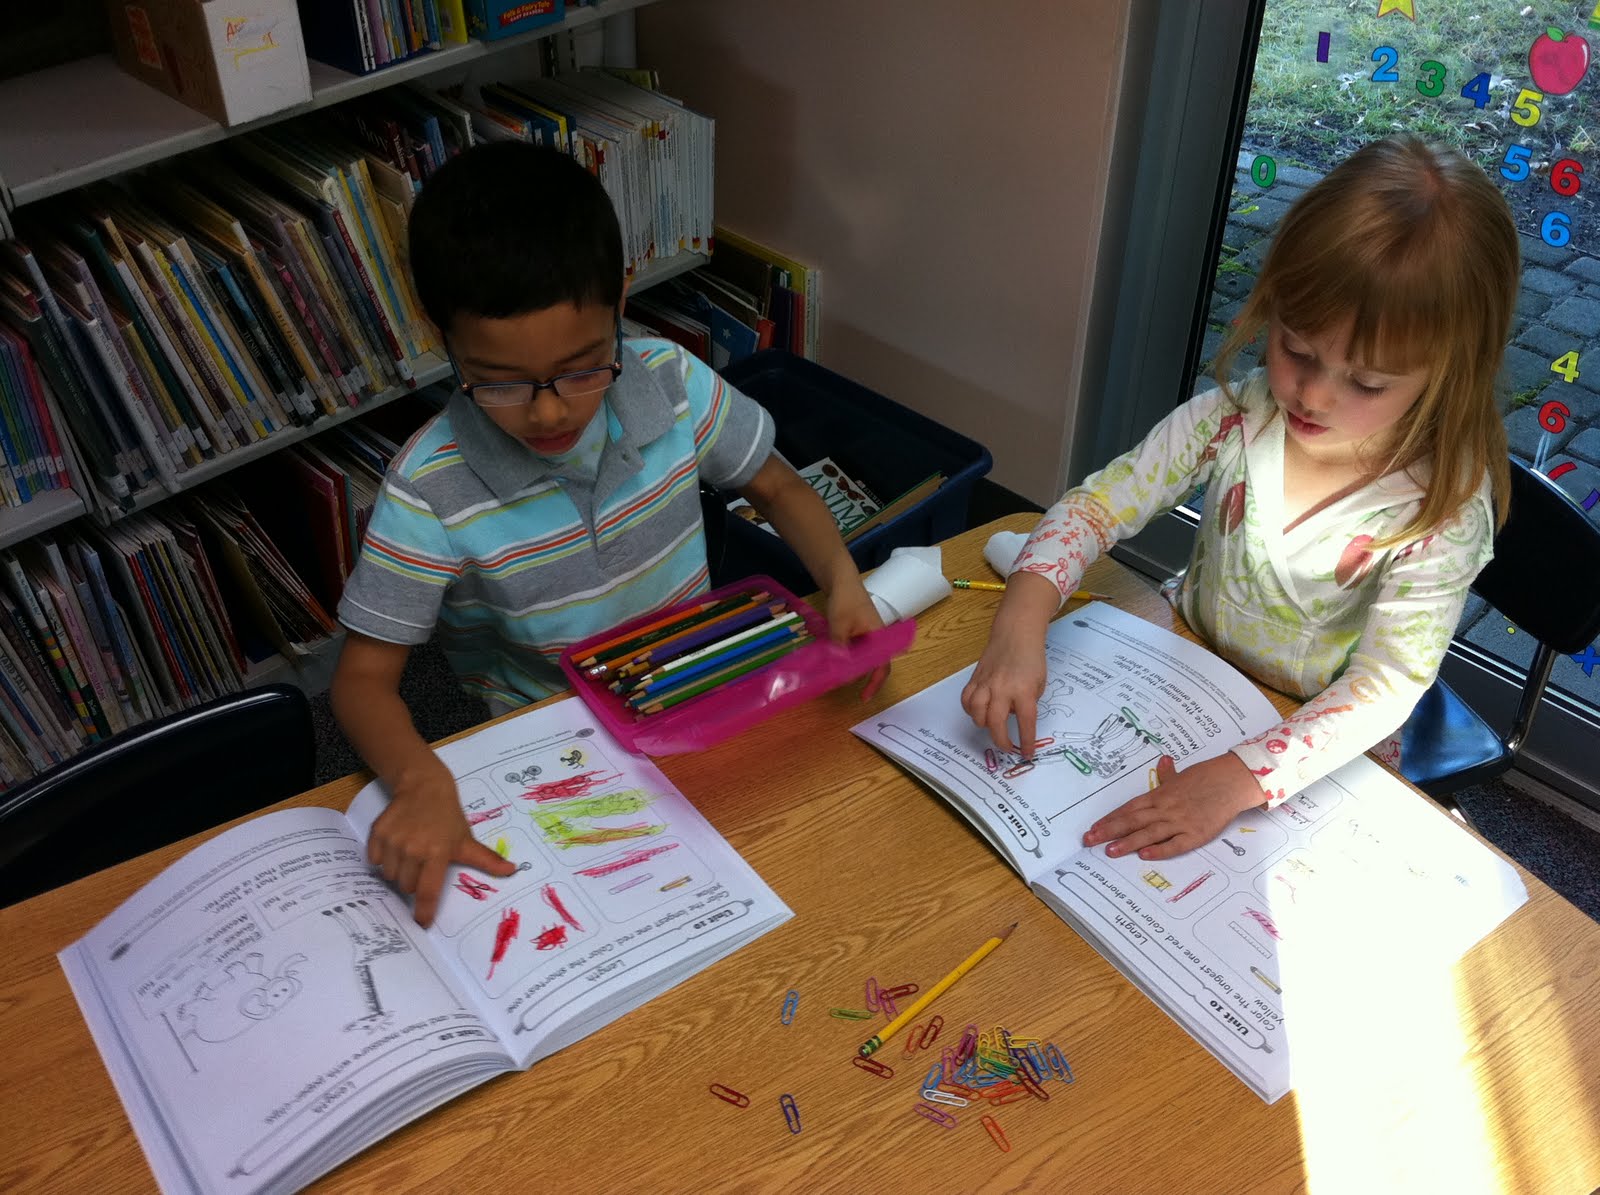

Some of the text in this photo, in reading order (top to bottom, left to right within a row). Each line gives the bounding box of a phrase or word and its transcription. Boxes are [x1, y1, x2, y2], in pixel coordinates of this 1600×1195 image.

[1371, 46, 1399, 82] 2
[1416, 60, 1447, 97] 3
[1461, 72, 1492, 109] 4
[1510, 88, 1544, 127] 5
[1500, 143, 1534, 182] 5
[1550, 159, 1584, 197] 6
[1540, 211, 1572, 247] 6
[1550, 350, 1581, 383] 4
[1538, 400, 1571, 434] 6
[1119, 681, 1134, 691] tall
[1140, 674, 1156, 687] that
[1149, 671, 1166, 684] that
[1116, 691, 1131, 702] tall
[1156, 684, 1182, 703] animal
[1166, 682, 1190, 701] animal
[1181, 701, 1194, 715] the
[1190, 700, 1203, 713] the
[1193, 714, 1215, 738] Circle
[1203, 713, 1221, 734] Color
[921, 746, 949, 766] Length
[951, 747, 970, 761] with
[968, 756, 999, 780] measure
[996, 778, 1016, 796] then
[1012, 793, 1029, 811] and
[996, 801, 1027, 838] Unit 10
[278, 854, 310, 870] animal
[280, 860, 312, 877] animal
[254, 866, 276, 881] that
[255, 874, 278, 889] that
[687, 900, 704, 913] the
[703, 888, 729, 906] Color
[653, 906, 687, 928] longest
[692, 907, 734, 931] Unit 10
[634, 923, 652, 936] one
[1112, 912, 1149, 946] Length
[587, 942, 613, 960] Color
[1074, 859, 1276, 1032] Color the longest one red. Color the shortest one
[568, 957, 585, 969] the
[584, 957, 625, 983] Length
[523, 966, 567, 999] shortest
[1208, 999, 1249, 1036] Unit 10
